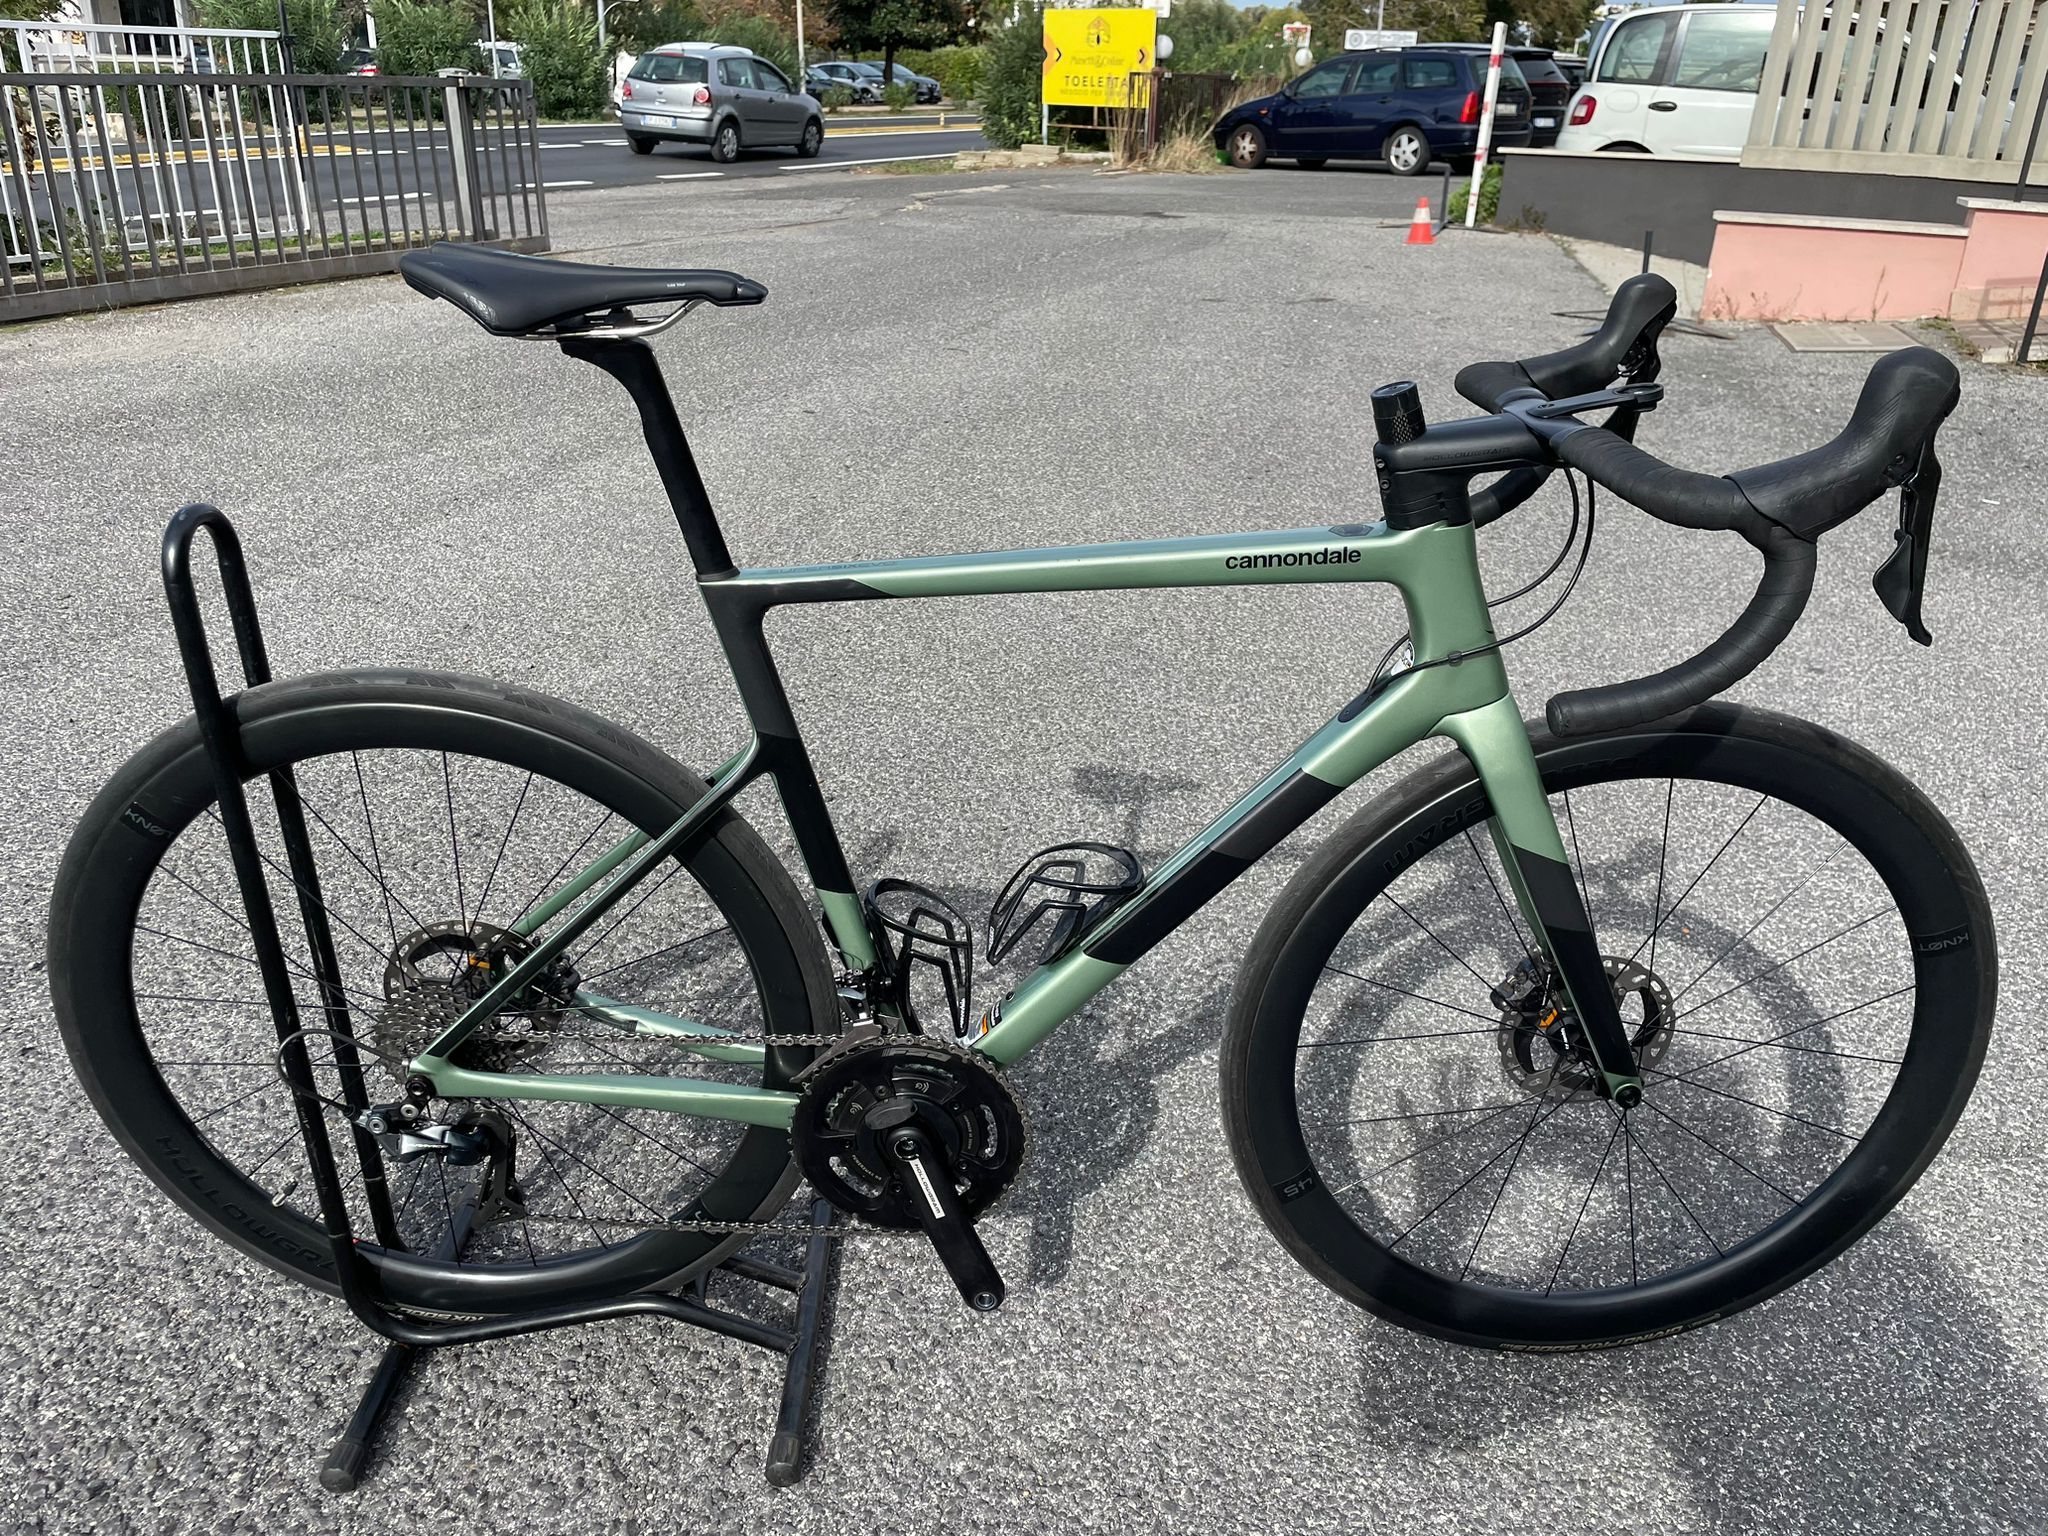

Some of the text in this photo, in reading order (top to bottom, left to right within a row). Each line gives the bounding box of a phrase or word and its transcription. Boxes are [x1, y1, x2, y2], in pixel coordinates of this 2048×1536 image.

[1065, 75, 1128, 88] TOELETTA
[1225, 546, 1362, 570] cannondale
[155, 1136, 337, 1269] HOLLOWGR
[914, 1163, 941, 1214] HOLLOWGRAM
